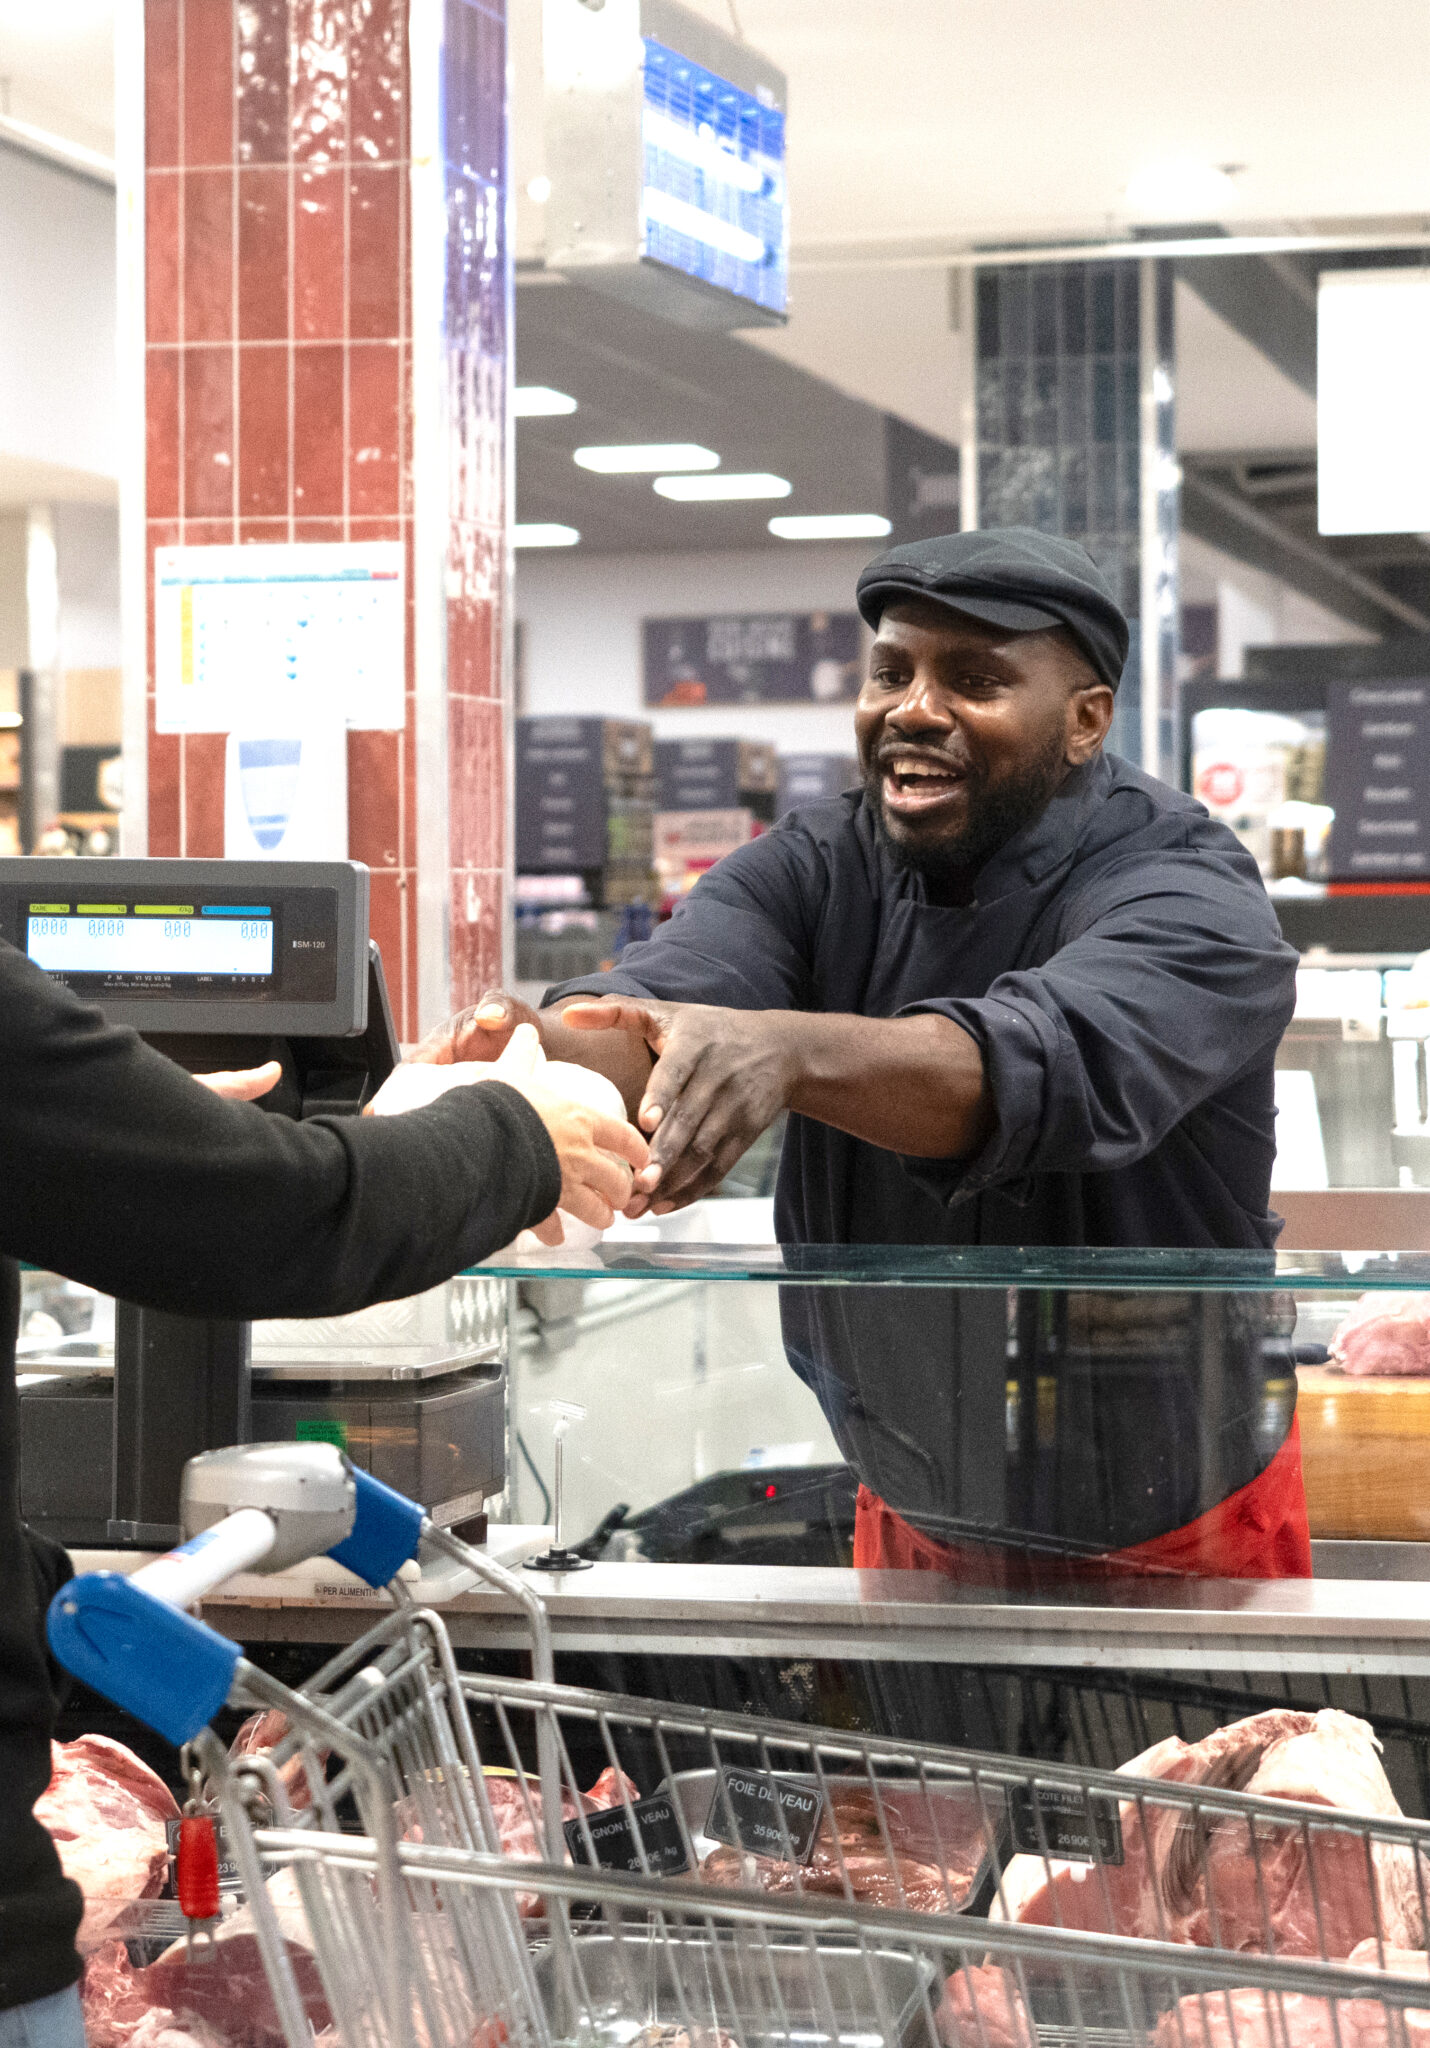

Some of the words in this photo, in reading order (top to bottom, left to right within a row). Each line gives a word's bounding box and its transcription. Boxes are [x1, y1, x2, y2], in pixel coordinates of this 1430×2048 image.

[297, 941, 326, 949] SM-120
[323, 1586, 337, 1595] PER
[339, 1587, 372, 1596] ALIMENTI
[727, 1778, 758, 1796] FOIE
[779, 1792, 813, 1811] VEAU
[577, 1822, 623, 1843] RGNON
[641, 1808, 670, 1825] VEAU
